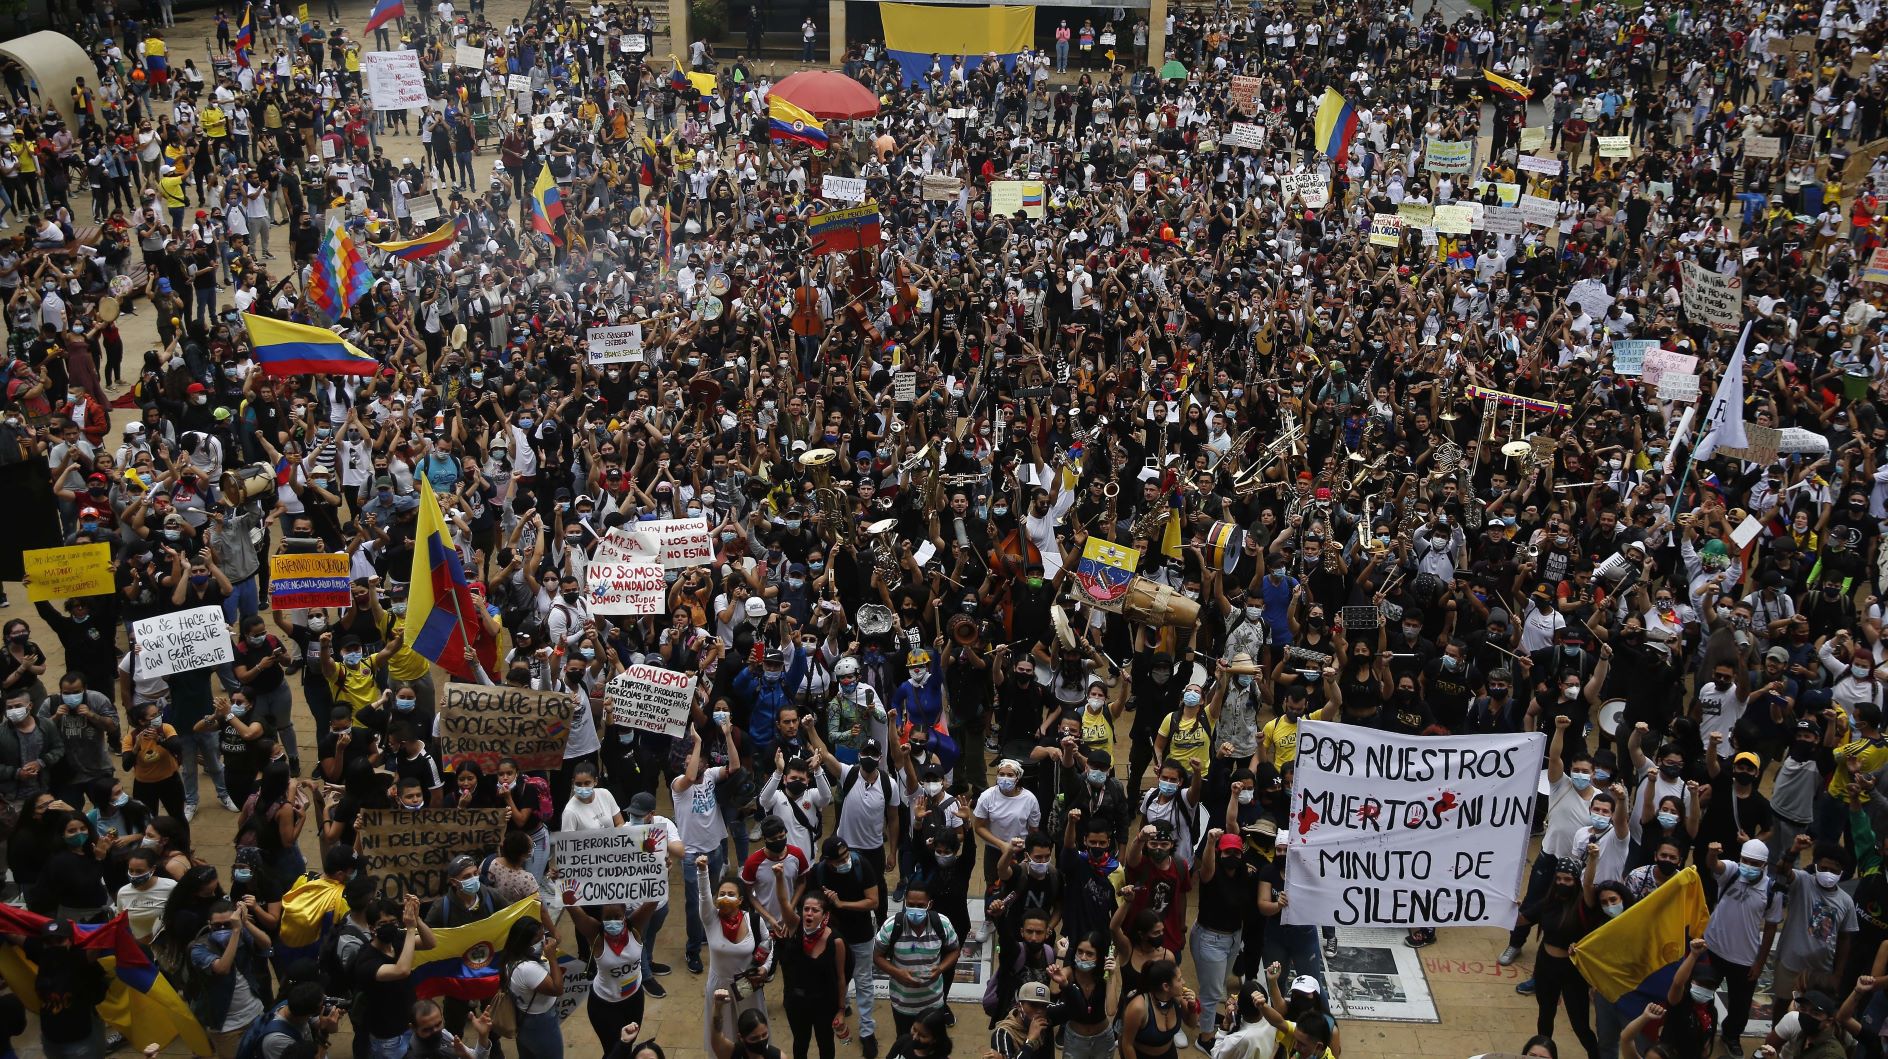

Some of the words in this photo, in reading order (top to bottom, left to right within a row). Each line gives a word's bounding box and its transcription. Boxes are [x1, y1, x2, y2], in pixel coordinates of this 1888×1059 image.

[824, 179, 860, 194] JUSTICIA
[591, 352, 603, 360] PERO
[665, 522, 704, 533] MARCHO
[604, 533, 643, 550] ARRIBA
[667, 536, 688, 546] LOS
[691, 534, 708, 543] QUE
[602, 546, 618, 556] LOS
[622, 553, 632, 562] DE
[667, 550, 681, 559] NO
[684, 545, 710, 558] ESTÁN
[1550, 552, 1568, 563] NO
[590, 565, 612, 579] NO
[617, 565, 663, 579] SOMOS
[1547, 560, 1567, 570] PUEDO
[591, 592, 621, 605] SOMOS
[635, 604, 656, 614] TES
[138, 623, 152, 636] NO
[160, 618, 173, 631] SE
[179, 614, 205, 630] HACE
[210, 609, 222, 623] UN
[167, 624, 220, 646] DIFERENTE
[145, 654, 163, 670] CON
[168, 645, 195, 661] GENTE
[172, 647, 225, 672] INDIFERENTE
[626, 667, 688, 688] NDALISMO
[621, 680, 652, 693] IMPORTAR
[654, 687, 688, 700] PRODUCTOS
[448, 688, 532, 715] DISCULPE
[537, 694, 574, 719] LAS
[636, 702, 670, 716] NUESTROS
[643, 694, 653, 702] DE
[654, 696, 672, 706] OTROS
[444, 715, 548, 738] MOLESTIAS
[635, 720, 667, 732] EXTREMA!
[441, 736, 477, 754] PERO
[480, 739, 510, 754] NOS
[1296, 733, 1355, 776] POR
[1366, 744, 1518, 781] NUESTROS
[363, 810, 382, 827] NI
[390, 809, 499, 826] TERRORISTAS
[1302, 788, 1447, 832] MUERTOS
[1457, 795, 1483, 829] NI
[1490, 796, 1532, 827] UN
[362, 833, 380, 849] NI
[388, 829, 501, 847] DELICUENTES
[557, 840, 567, 851] NI
[570, 834, 634, 852] TERRORISTA
[367, 852, 420, 870] SOMOS
[556, 855, 566, 865] NI
[570, 852, 656, 865] DELINCUENTES
[1319, 849, 1432, 881] MINUTO
[1455, 851, 1494, 879] DE
[558, 867, 593, 879] SOMOS
[598, 864, 662, 878] CIUDADANOS
[583, 878, 666, 901] CONSCIENTES
[1334, 887, 1489, 926] SILENCIO.
